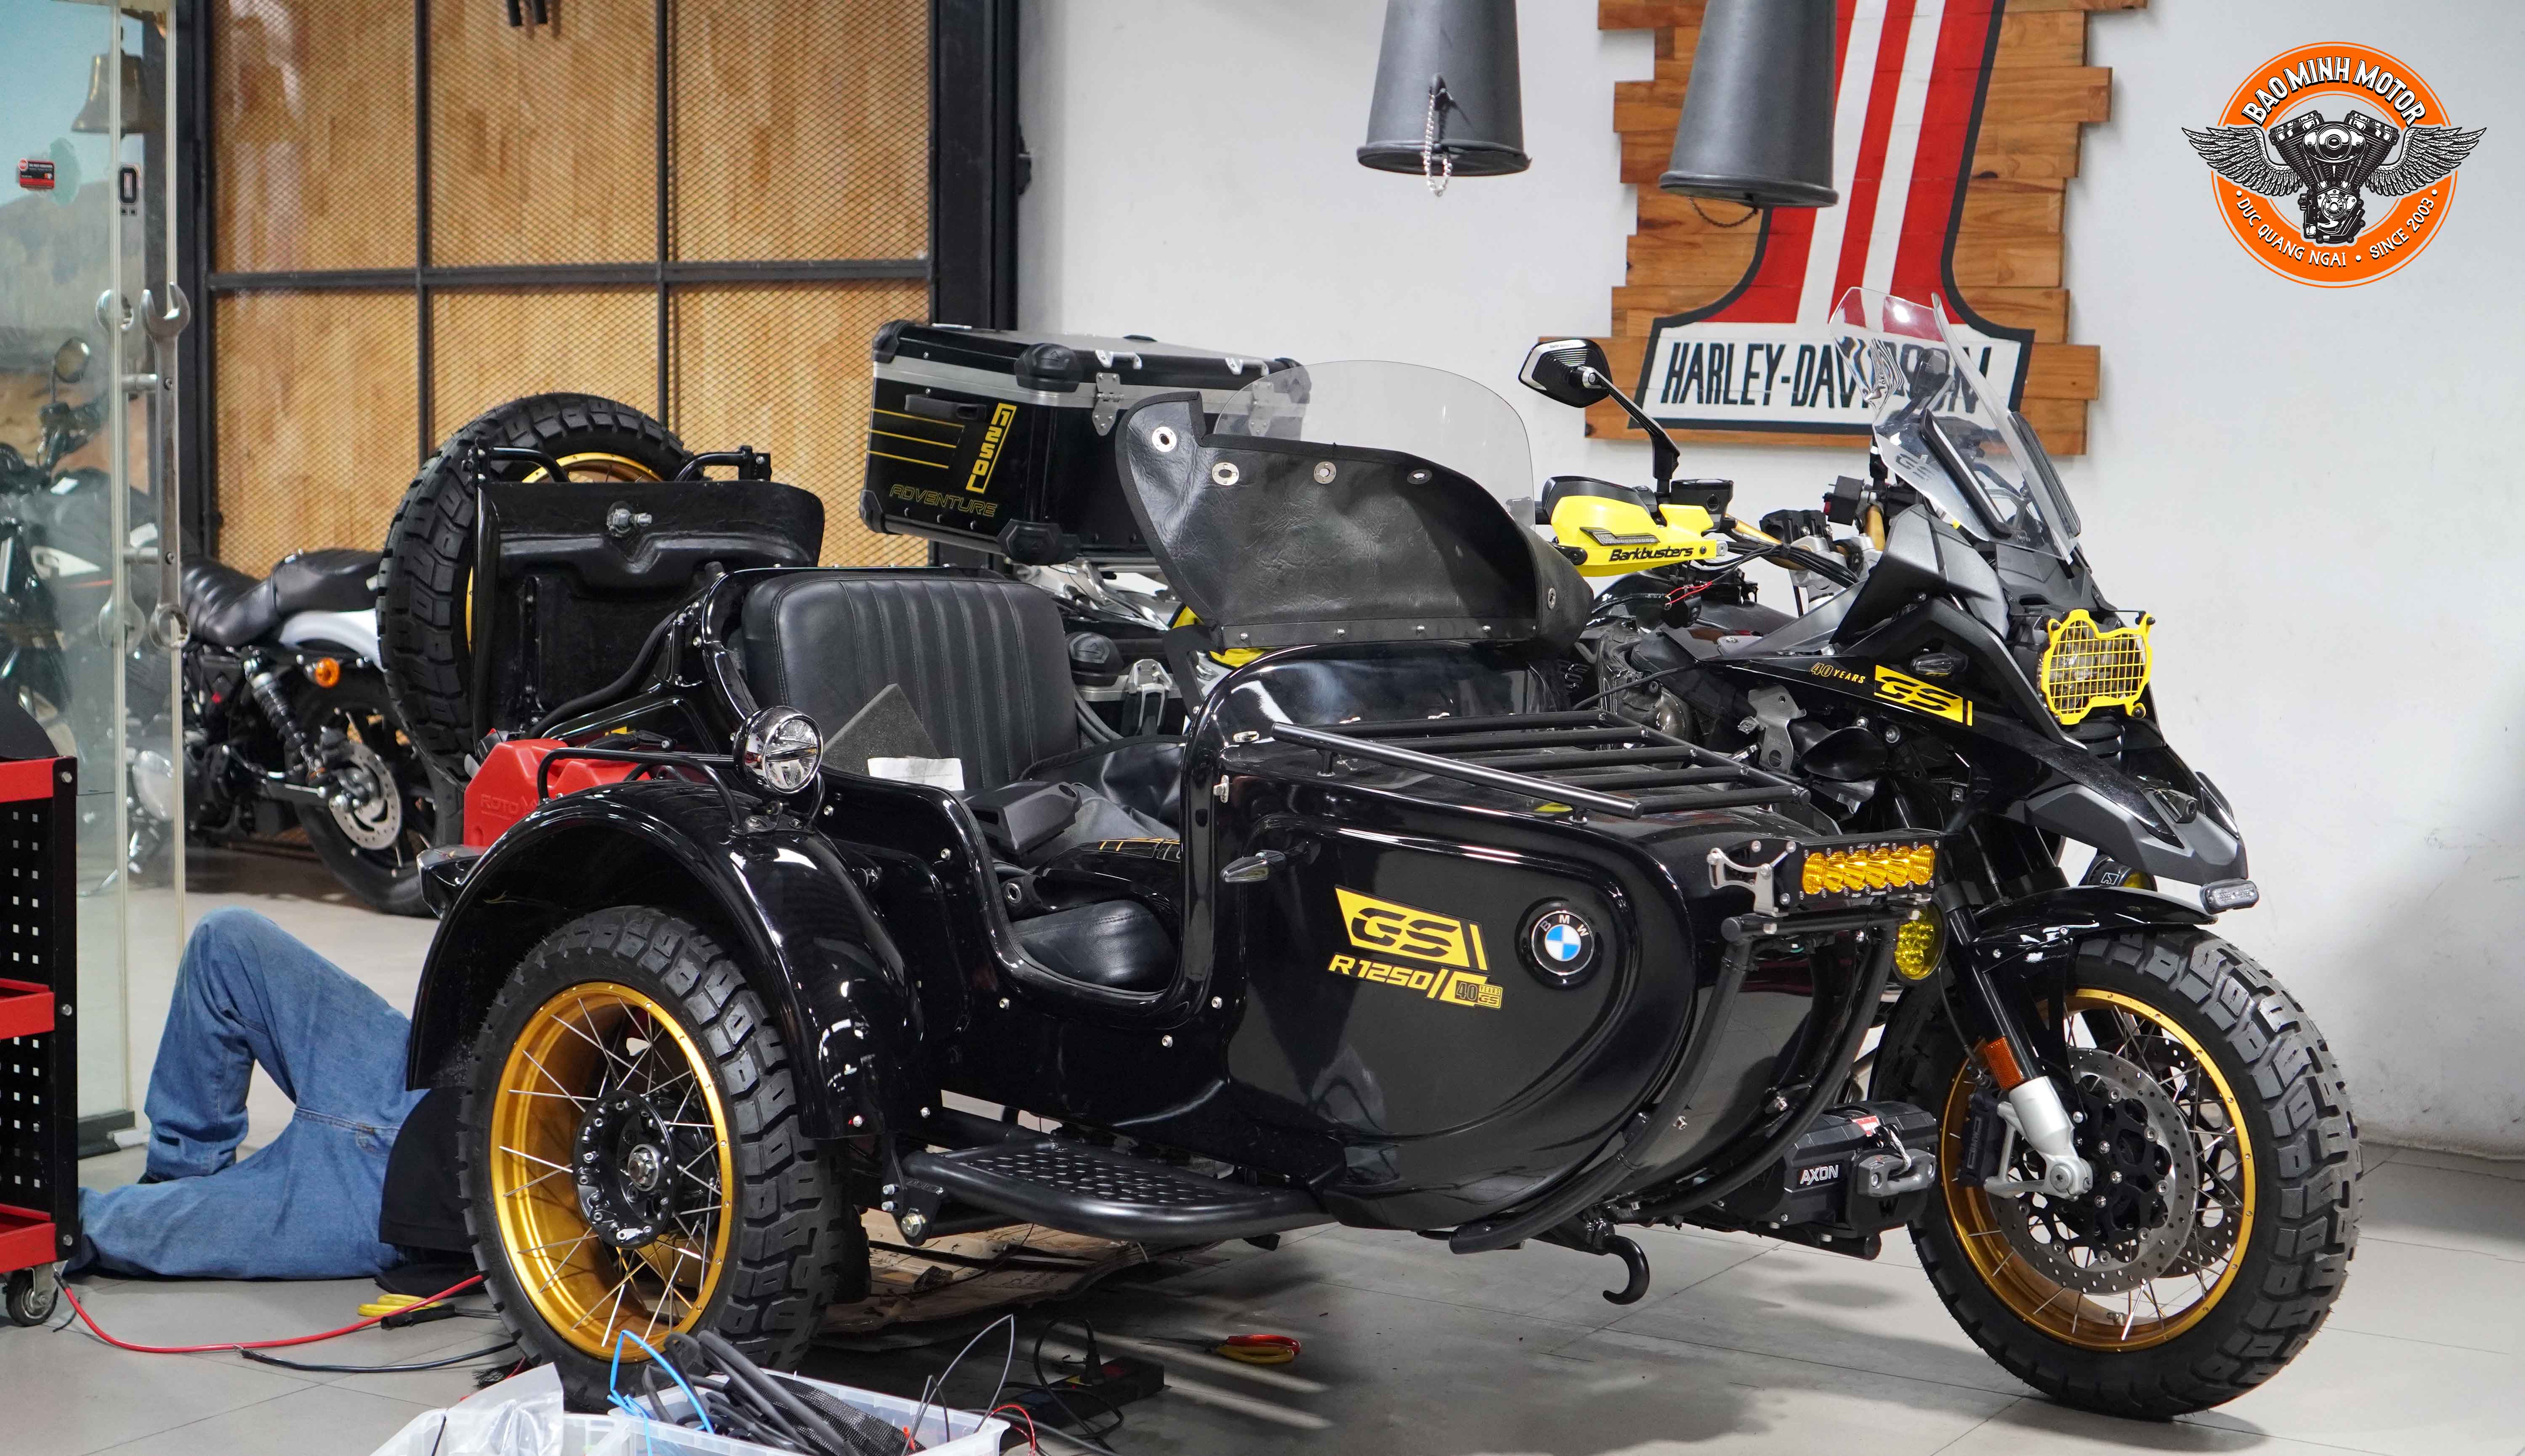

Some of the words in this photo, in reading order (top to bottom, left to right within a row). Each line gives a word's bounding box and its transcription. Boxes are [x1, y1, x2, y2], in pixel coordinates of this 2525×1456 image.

[889, 484, 998, 517] ADVENTURE
[1608, 546, 1694, 561] Barkbusters
[1811, 662, 1834, 677] 40
[1834, 670, 1866, 683] YEARS
[1875, 676, 1961, 712] GS
[1350, 907, 1459, 957] GS
[1539, 914, 1590, 938] BMW
[1457, 982, 1478, 1001] 40
[1480, 986, 1500, 995] YEARS
[1479, 995, 1499, 1004] GS
[1800, 1164, 1839, 1185] AXON
